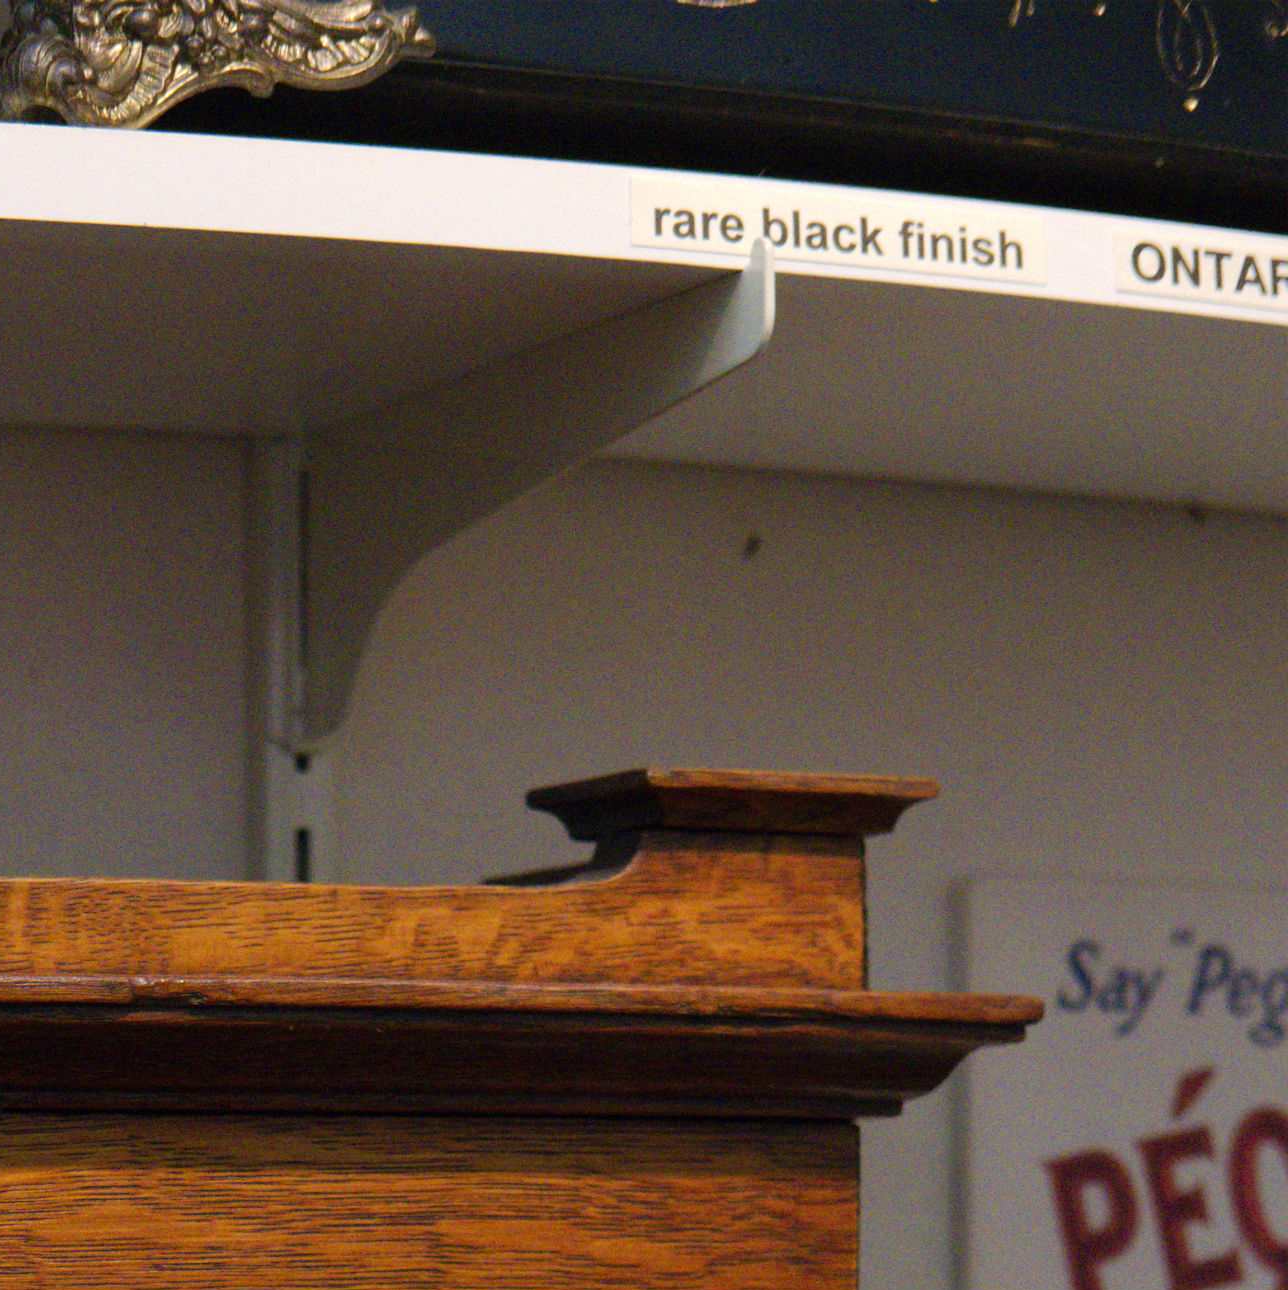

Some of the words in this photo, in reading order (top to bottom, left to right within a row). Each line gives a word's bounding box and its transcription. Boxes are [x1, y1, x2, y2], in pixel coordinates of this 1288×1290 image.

[652, 205, 746, 243] rare
[759, 206, 885, 256] black
[898, 220, 1025, 271] finish
[1055, 938, 1164, 1038] Say
